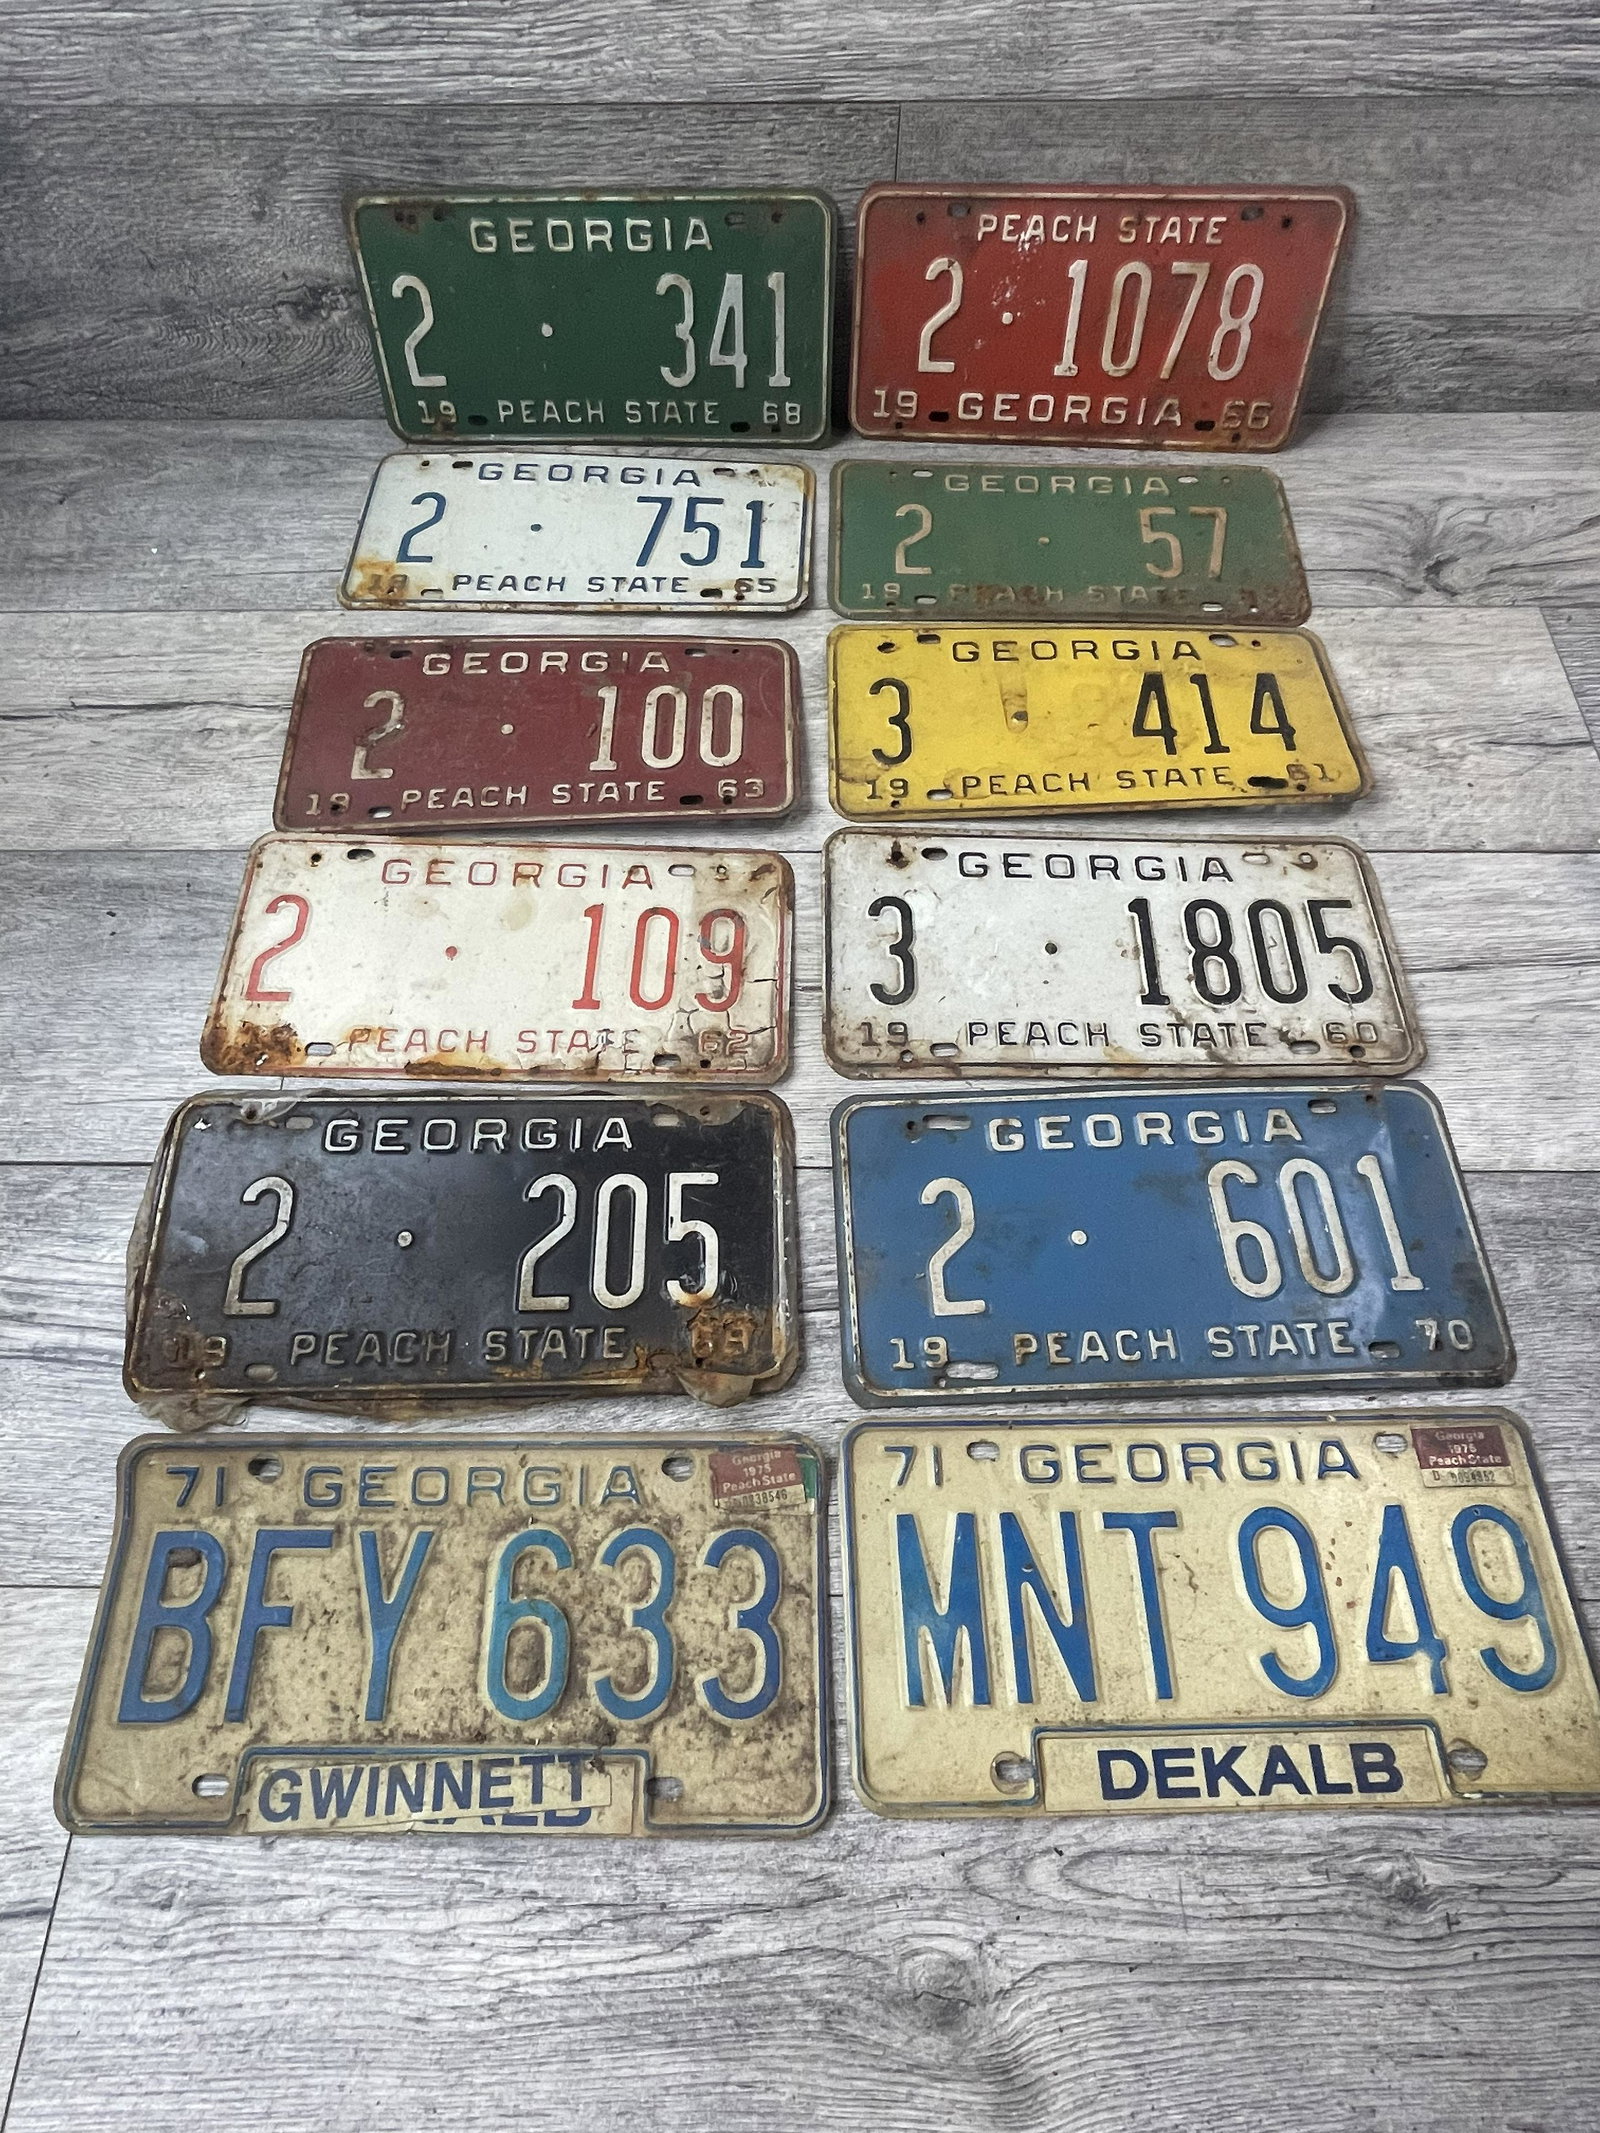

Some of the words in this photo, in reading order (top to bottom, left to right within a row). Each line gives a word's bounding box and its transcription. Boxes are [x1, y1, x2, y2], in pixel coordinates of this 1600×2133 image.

[470, 217, 713, 253] GEORGIA
[977, 214, 1096, 244] PEACH
[1118, 215, 1228, 245] STATE
[392, 275, 447, 387] 2
[655, 272, 791, 388] 341
[917, 257, 964, 373] 2
[1053, 259, 1264, 381] 1078
[418, 400, 458, 424] 19
[499, 400, 604, 424] PEACH
[625, 402, 720, 424] STATE
[762, 402, 801, 425] 68
[873, 390, 918, 419] 19
[957, 392, 1183, 426] GEORGIA
[478, 462, 701, 487] GEORGIA
[944, 474, 1170, 495] GEORGIA
[396, 491, 447, 564] 2
[635, 496, 767, 569] 751
[894, 503, 934, 575] 2
[1138, 506, 1229, 579] 57
[451, 575, 565, 592] PEACH
[587, 576, 689, 593] STATE
[734, 577, 777, 593] 65
[422, 651, 670, 676] GEORGIA
[952, 640, 1201, 663] GEORGIA
[350, 691, 405, 780] 2
[589, 684, 743, 771] 100
[869, 678, 913, 765] 3
[1132, 671, 1297, 756] 414
[401, 785, 527, 811] PEACH
[552, 780, 666, 804] STATE
[717, 778, 764, 799] 63
[865, 777, 910, 800] 19
[962, 773, 1090, 798] PEACH
[1118, 766, 1231, 790] STATE
[381, 859, 654, 889] GEORGIA
[958, 851, 1233, 883] GEORGIA
[244, 893, 309, 1002] 2
[571, 903, 746, 1013] 109
[867, 895, 915, 1006] 3
[1127, 898, 1374, 1006] 1805
[348, 1027, 488, 1054] PEACH
[516, 1029, 640, 1054] STATE
[860, 1022, 908, 1047] 19
[967, 1021, 1108, 1046] PEACH
[1140, 1022, 1268, 1048] STATE
[1323, 1022, 1379, 1044] 60
[323, 1116, 633, 1153] GEORGIA
[988, 1109, 1302, 1152] GEORGIA
[223, 1176, 294, 1316] 2
[518, 1171, 719, 1311] 205
[920, 1177, 987, 1316] 2
[1207, 1154, 1424, 1299] 601
[290, 1330, 450, 1365] PEACH
[485, 1327, 626, 1362] STATE
[889, 1336, 949, 1370] 19
[1012, 1329, 1178, 1364] PEACH
[1206, 1320, 1355, 1360] STATE
[1414, 1319, 1474, 1351] 70
[1435, 1431, 1484, 1442] Georgia
[732, 1451, 781, 1465] Georgia
[743, 1463, 771, 1477] 1975
[884, 1445, 941, 1486] 71
[1021, 1441, 1361, 1483] GEORGIA
[1429, 1455, 1466, 1466] Peach
[1467, 1454, 1502, 1464] State
[165, 1465, 228, 1507] 71
[303, 1465, 642, 1507] GEORGIA
[723, 1478, 761, 1493] Peach
[762, 1473, 796, 1486] State
[896, 1510, 1179, 1708] MNT
[1238, 1503, 1559, 1698] 949
[116, 1529, 434, 1724] BFY
[489, 1527, 783, 1721] 633
[258, 1753, 594, 1823] GWINNETT
[1098, 1743, 1403, 1800] DEKALB
